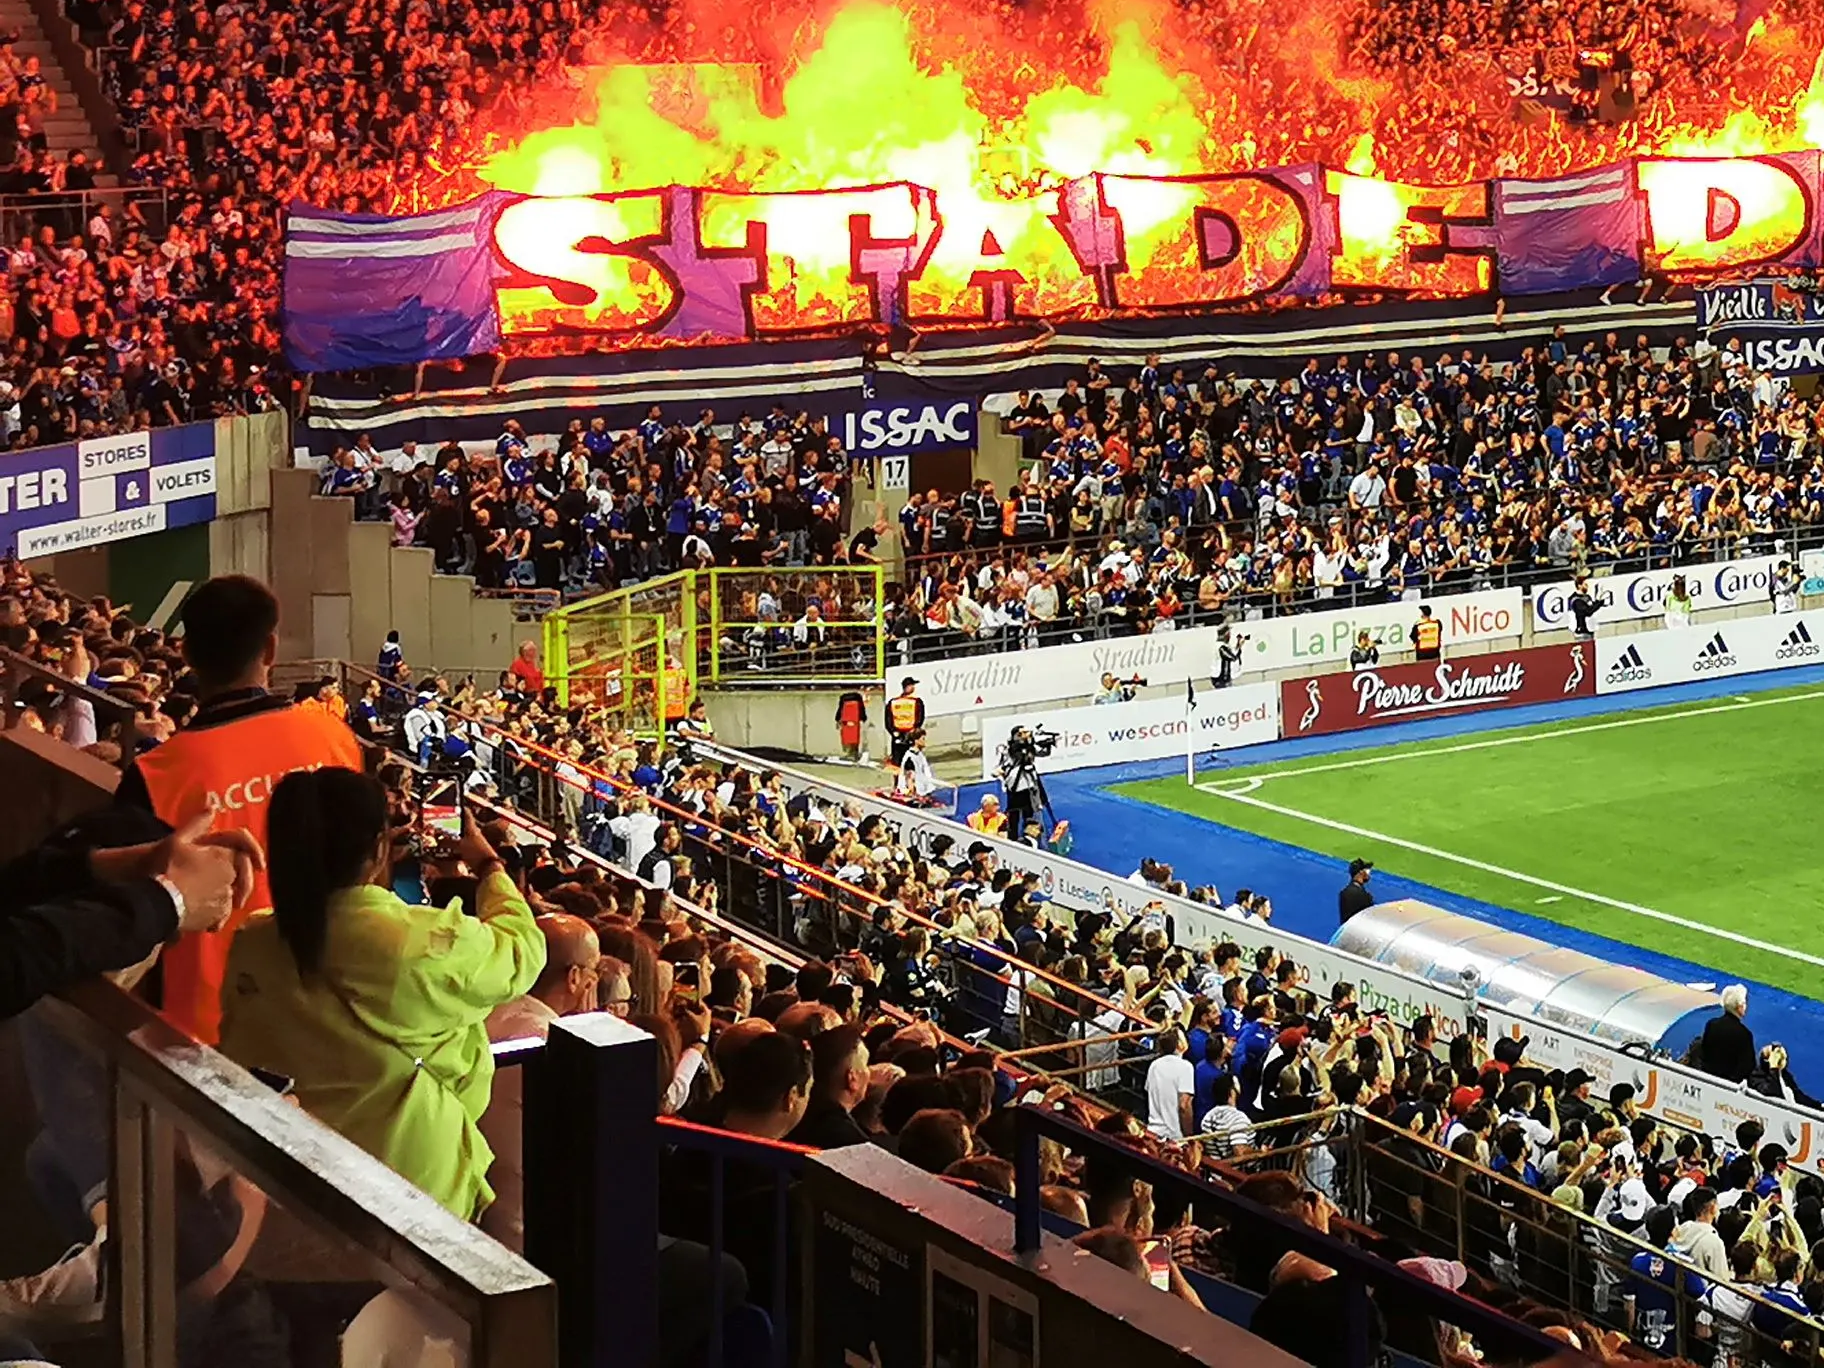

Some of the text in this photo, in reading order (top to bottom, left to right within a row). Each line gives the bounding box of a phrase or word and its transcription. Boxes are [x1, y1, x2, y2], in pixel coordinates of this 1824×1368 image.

[494, 172, 1495, 335] STADE
[845, 402, 970, 451] ISSAC
[84, 444, 147, 468] STORES
[885, 459, 905, 480] 17
[156, 468, 212, 492] VOLETS
[1291, 627, 1325, 658] La
[1452, 606, 1510, 638] Nico
[1090, 638, 1176, 674] Stradim
[930, 661, 1023, 696] Stradim
[1352, 663, 1525, 715] Pierre Schmidt
[1360, 978, 1399, 1016] Pizza
[1402, 994, 1422, 1021] de
